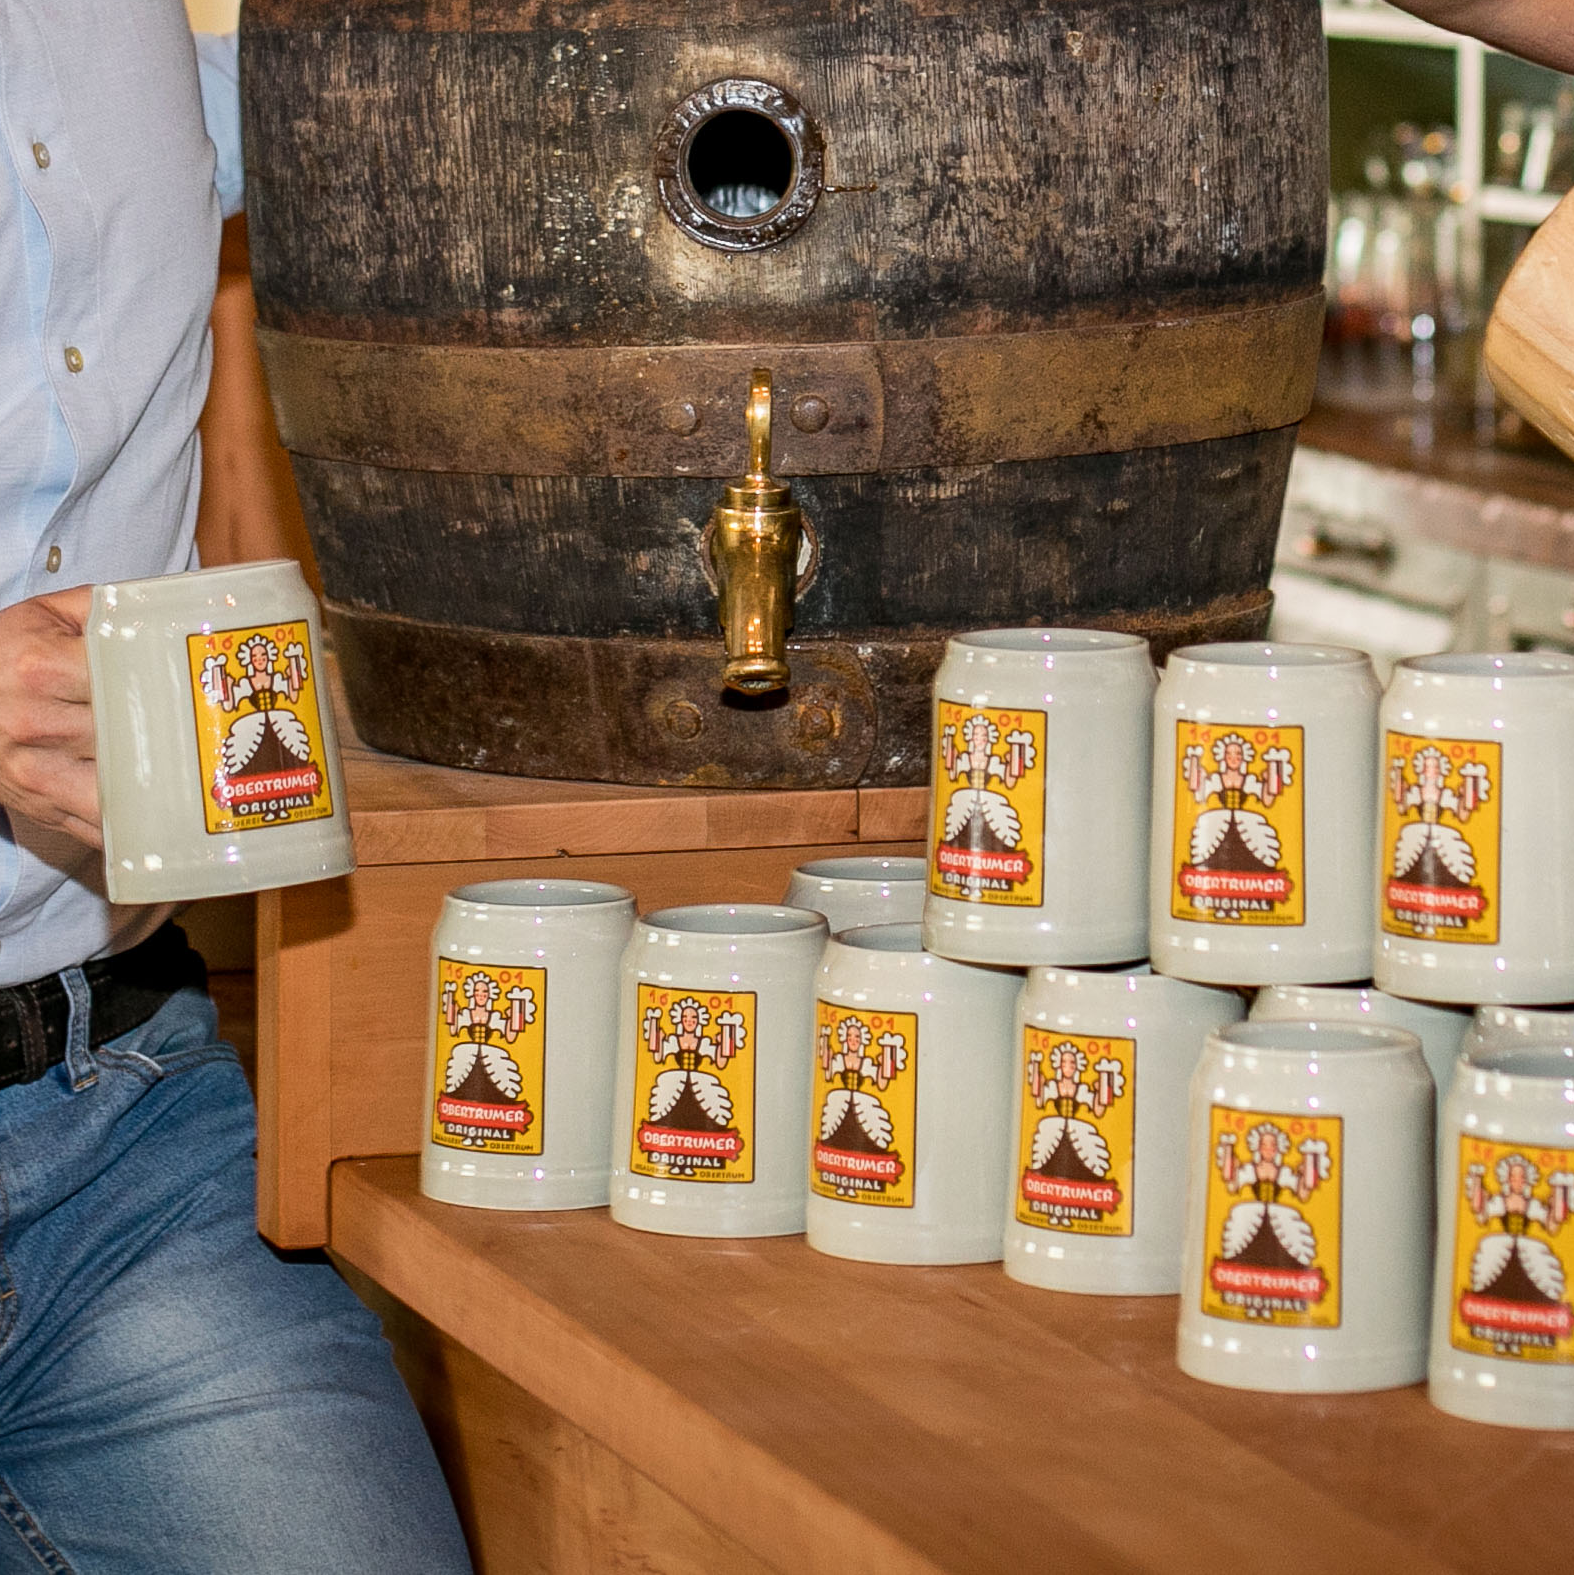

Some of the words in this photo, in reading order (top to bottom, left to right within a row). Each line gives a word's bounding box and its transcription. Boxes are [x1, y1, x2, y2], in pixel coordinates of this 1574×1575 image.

[207, 636, 233, 652] 16
[275, 628, 295, 643] 01
[944, 708, 962, 723] 16
[999, 715, 1022, 728] 01
[1189, 726, 1210, 743] 16
[1255, 731, 1280, 745] 01
[222, 771, 317, 798] OBERTRUMER
[238, 796, 310, 814] ORIGINAL
[940, 850, 1023, 873] OBERTRUMER
[944, 873, 1008, 889] ORIGINAL
[1185, 874, 1285, 892] OBERTRUMER
[1193, 895, 1270, 910] ORIGINAL
[446, 964, 463, 979] 16
[500, 971, 523, 985] 01
[649, 990, 669, 1005] 16
[710, 997, 733, 1009] 01
[871, 1017, 894, 1030] 01
[1031, 1033, 1049, 1048] 16
[1087, 1042, 1111, 1055] 01
[441, 1103, 524, 1123] OBERTRUMER
[447, 1124, 510, 1138] ORIGINAL
[644, 1131, 736, 1150] OBERTRUMER
[651, 1153, 721, 1167] ORIGINAL
[817, 1151, 896, 1173] OBERTRUMER
[822, 1172, 881, 1190] ORIGINAL
[1026, 1178, 1113, 1201] OBERTRUMER
[1032, 1201, 1098, 1219] ORIGINAL
